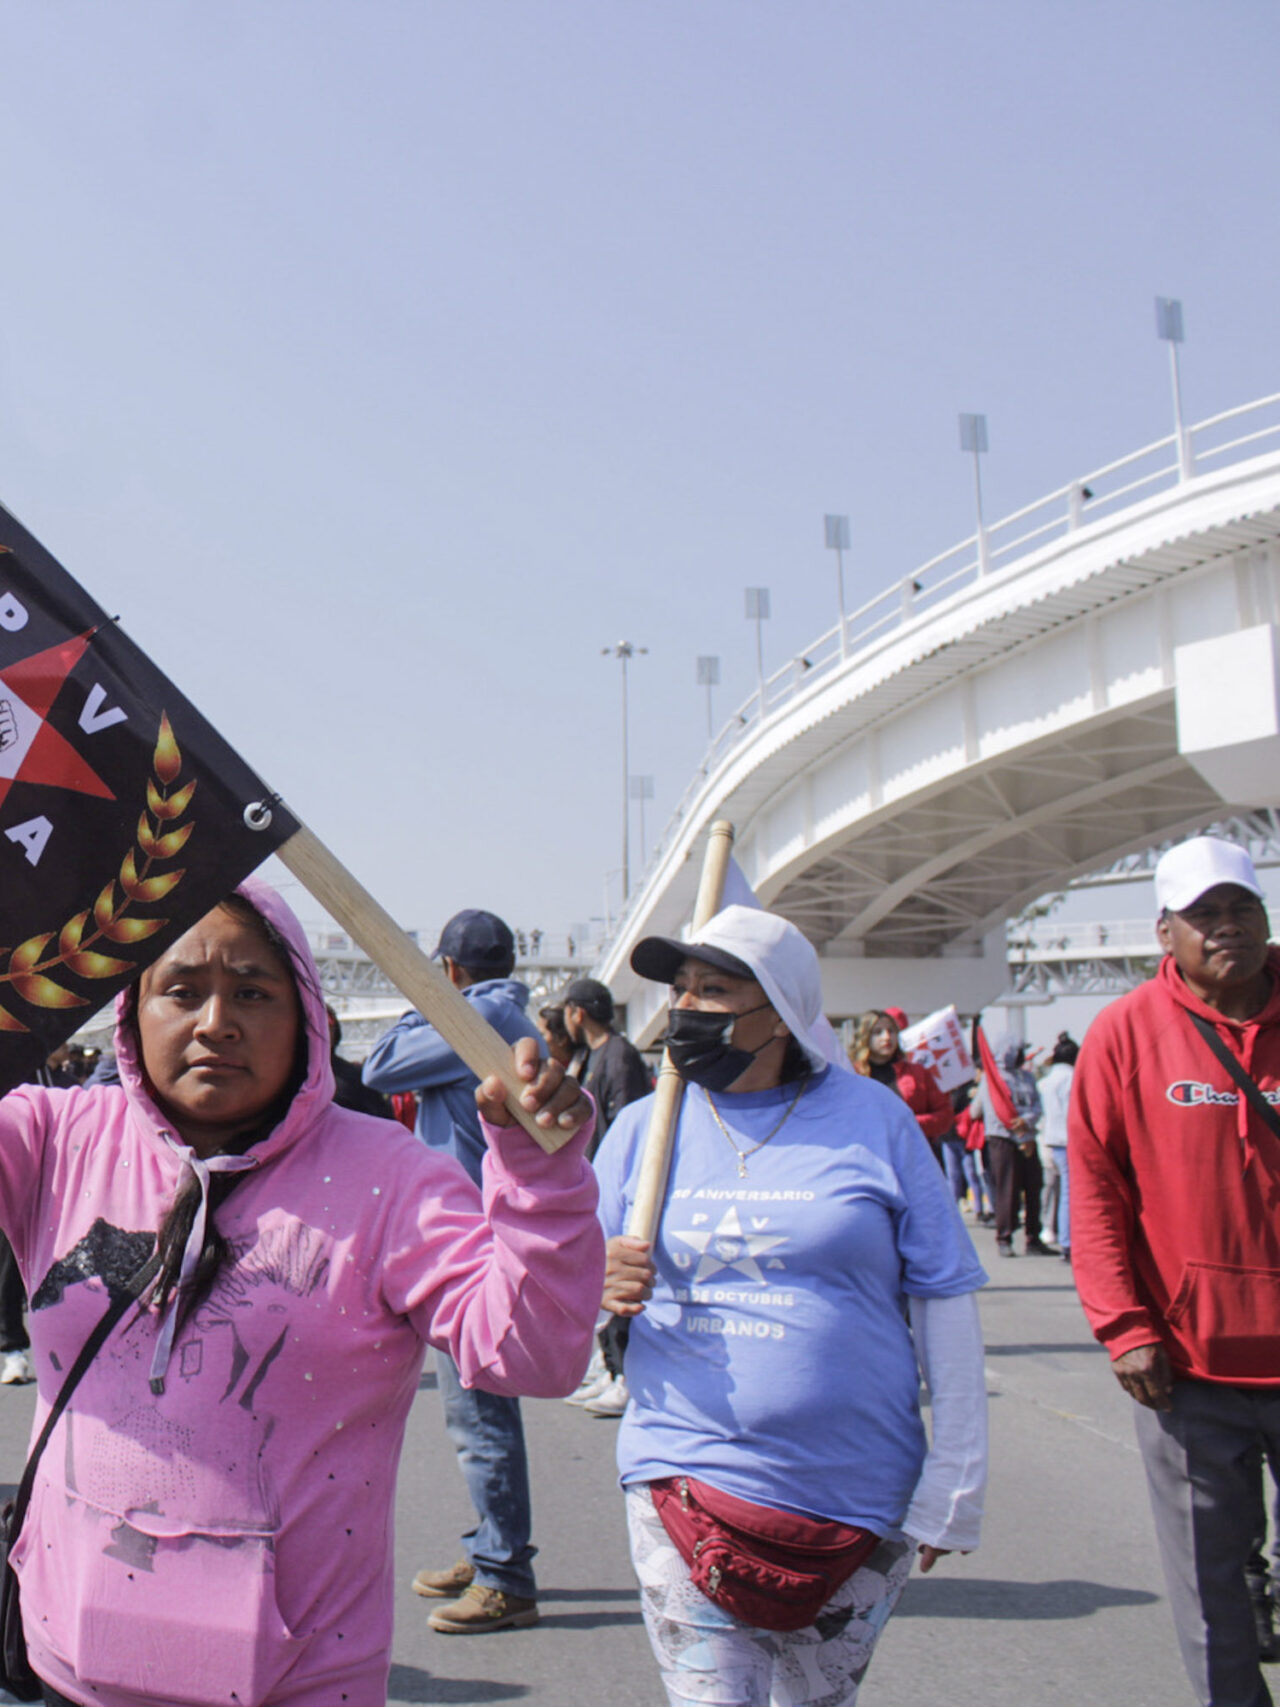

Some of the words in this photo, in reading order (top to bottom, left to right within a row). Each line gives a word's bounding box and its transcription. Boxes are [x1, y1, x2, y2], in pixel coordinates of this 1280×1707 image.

[76, 682, 128, 735] V
[4, 814, 55, 867] A
[692, 1188, 815, 1201] ANIVERSARIO
[692, 1213, 709, 1226] P
[750, 1216, 769, 1230] V
[672, 1251, 691, 1269] U
[766, 1257, 786, 1270] A
[714, 1290, 794, 1306] OCTUBRE
[686, 1316, 785, 1340] URBANOS
